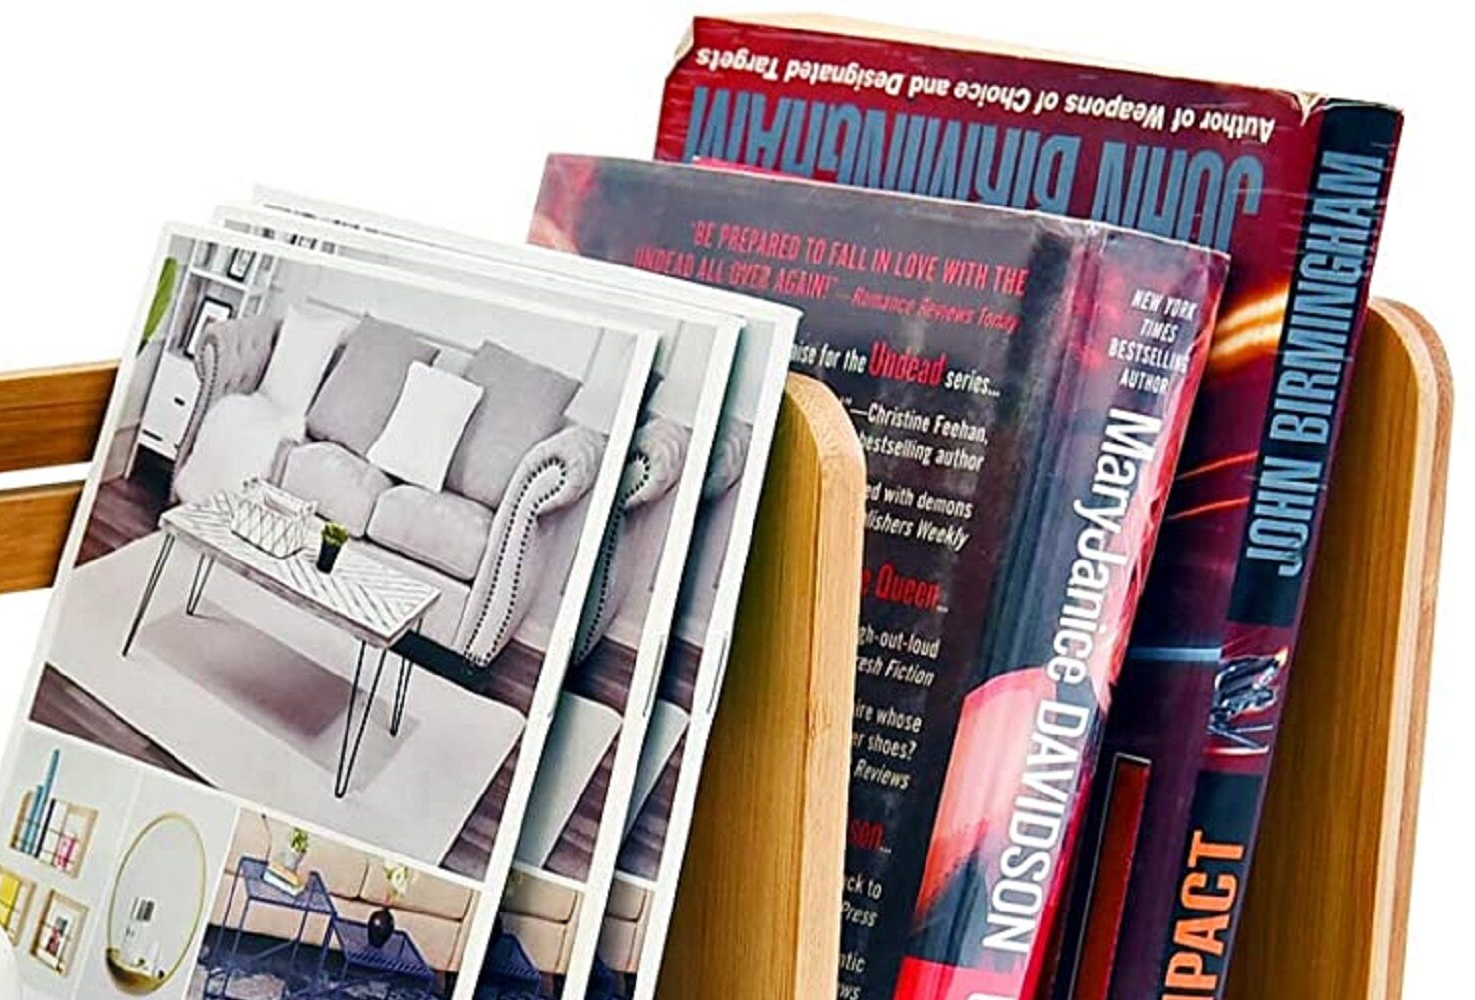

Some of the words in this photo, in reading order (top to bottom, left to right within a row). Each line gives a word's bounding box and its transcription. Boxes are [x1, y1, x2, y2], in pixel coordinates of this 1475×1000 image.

[695, 46, 779, 81] Targets
[784, 59, 905, 95] Designated
[909, 75, 951, 99] and
[954, 80, 1032, 113] Choice
[1033, 89, 1059, 116] of
[1064, 93, 1164, 131] Weapons
[1171, 108, 1197, 133] of
[1200, 106, 1275, 144] Author
[682, 84, 1082, 217] BIRMINGHAM
[1091, 141, 1264, 252] JOHN
[718, 223, 802, 262] PREPARED
[805, 236, 827, 265] TO
[828, 241, 867, 271] FALL
[870, 247, 892, 274] IN
[894, 251, 939, 283] LOVE
[942, 257, 988, 291] WITH
[992, 263, 1030, 298] THE
[633, 245, 696, 278] UNDEAD
[697, 256, 725, 284] ALL
[728, 260, 773, 291] OVER
[977, 305, 1021, 336] Today
[1131, 288, 1164, 313] NEW
[1163, 296, 1198, 321] YORK
[1269, 149, 1385, 444] BIRMINGHAM
[1140, 318, 1179, 343] TIMES
[819, 342, 842, 368] for
[843, 347, 868, 374] the
[867, 341, 947, 388] Undead
[1108, 337, 1190, 375] BESTSELLING
[1120, 367, 1169, 395] AUTHOR
[933, 414, 989, 446] Feehan,
[935, 446, 985, 473] author
[884, 485, 915, 508] with
[916, 491, 974, 519] demons
[1246, 455, 1324, 578] JOHN
[916, 518, 971, 552] Weekly
[1046, 407, 1163, 685] MaryJanice
[858, 622, 941, 659] gh-out-loud
[884, 658, 935, 688] Fiction
[876, 705, 923, 733] whose
[867, 733, 918, 761] shoes?
[853, 758, 911, 790] Reviews
[982, 699, 1090, 953] DAVIDSON
[867, 879, 882, 900] to
